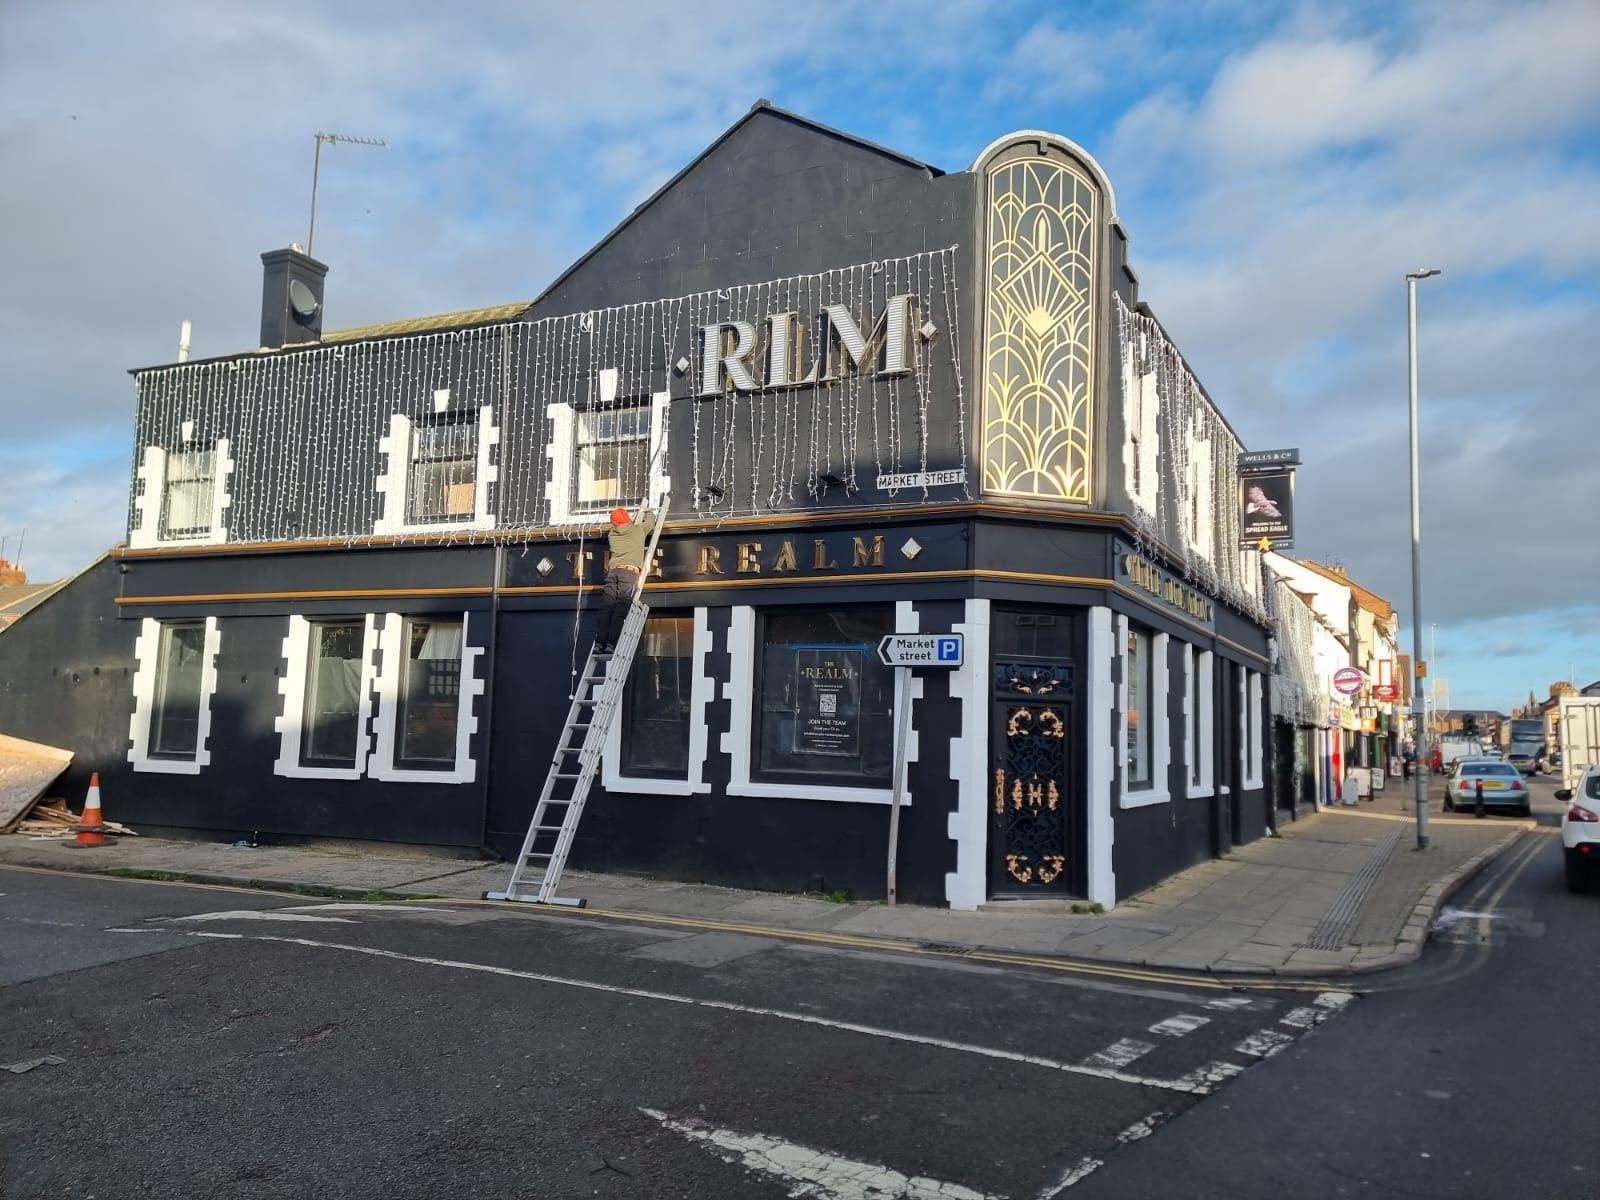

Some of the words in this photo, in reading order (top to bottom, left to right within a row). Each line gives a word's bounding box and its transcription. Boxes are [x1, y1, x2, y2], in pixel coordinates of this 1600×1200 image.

[700, 293, 914, 396] RLM
[880, 475, 918, 488] MARKET
[925, 471, 962, 484] STREET
[696, 535, 884, 575] REALM
[897, 639, 935, 649] Market
[899, 650, 932, 661] street
[805, 667, 853, 680] REALM
